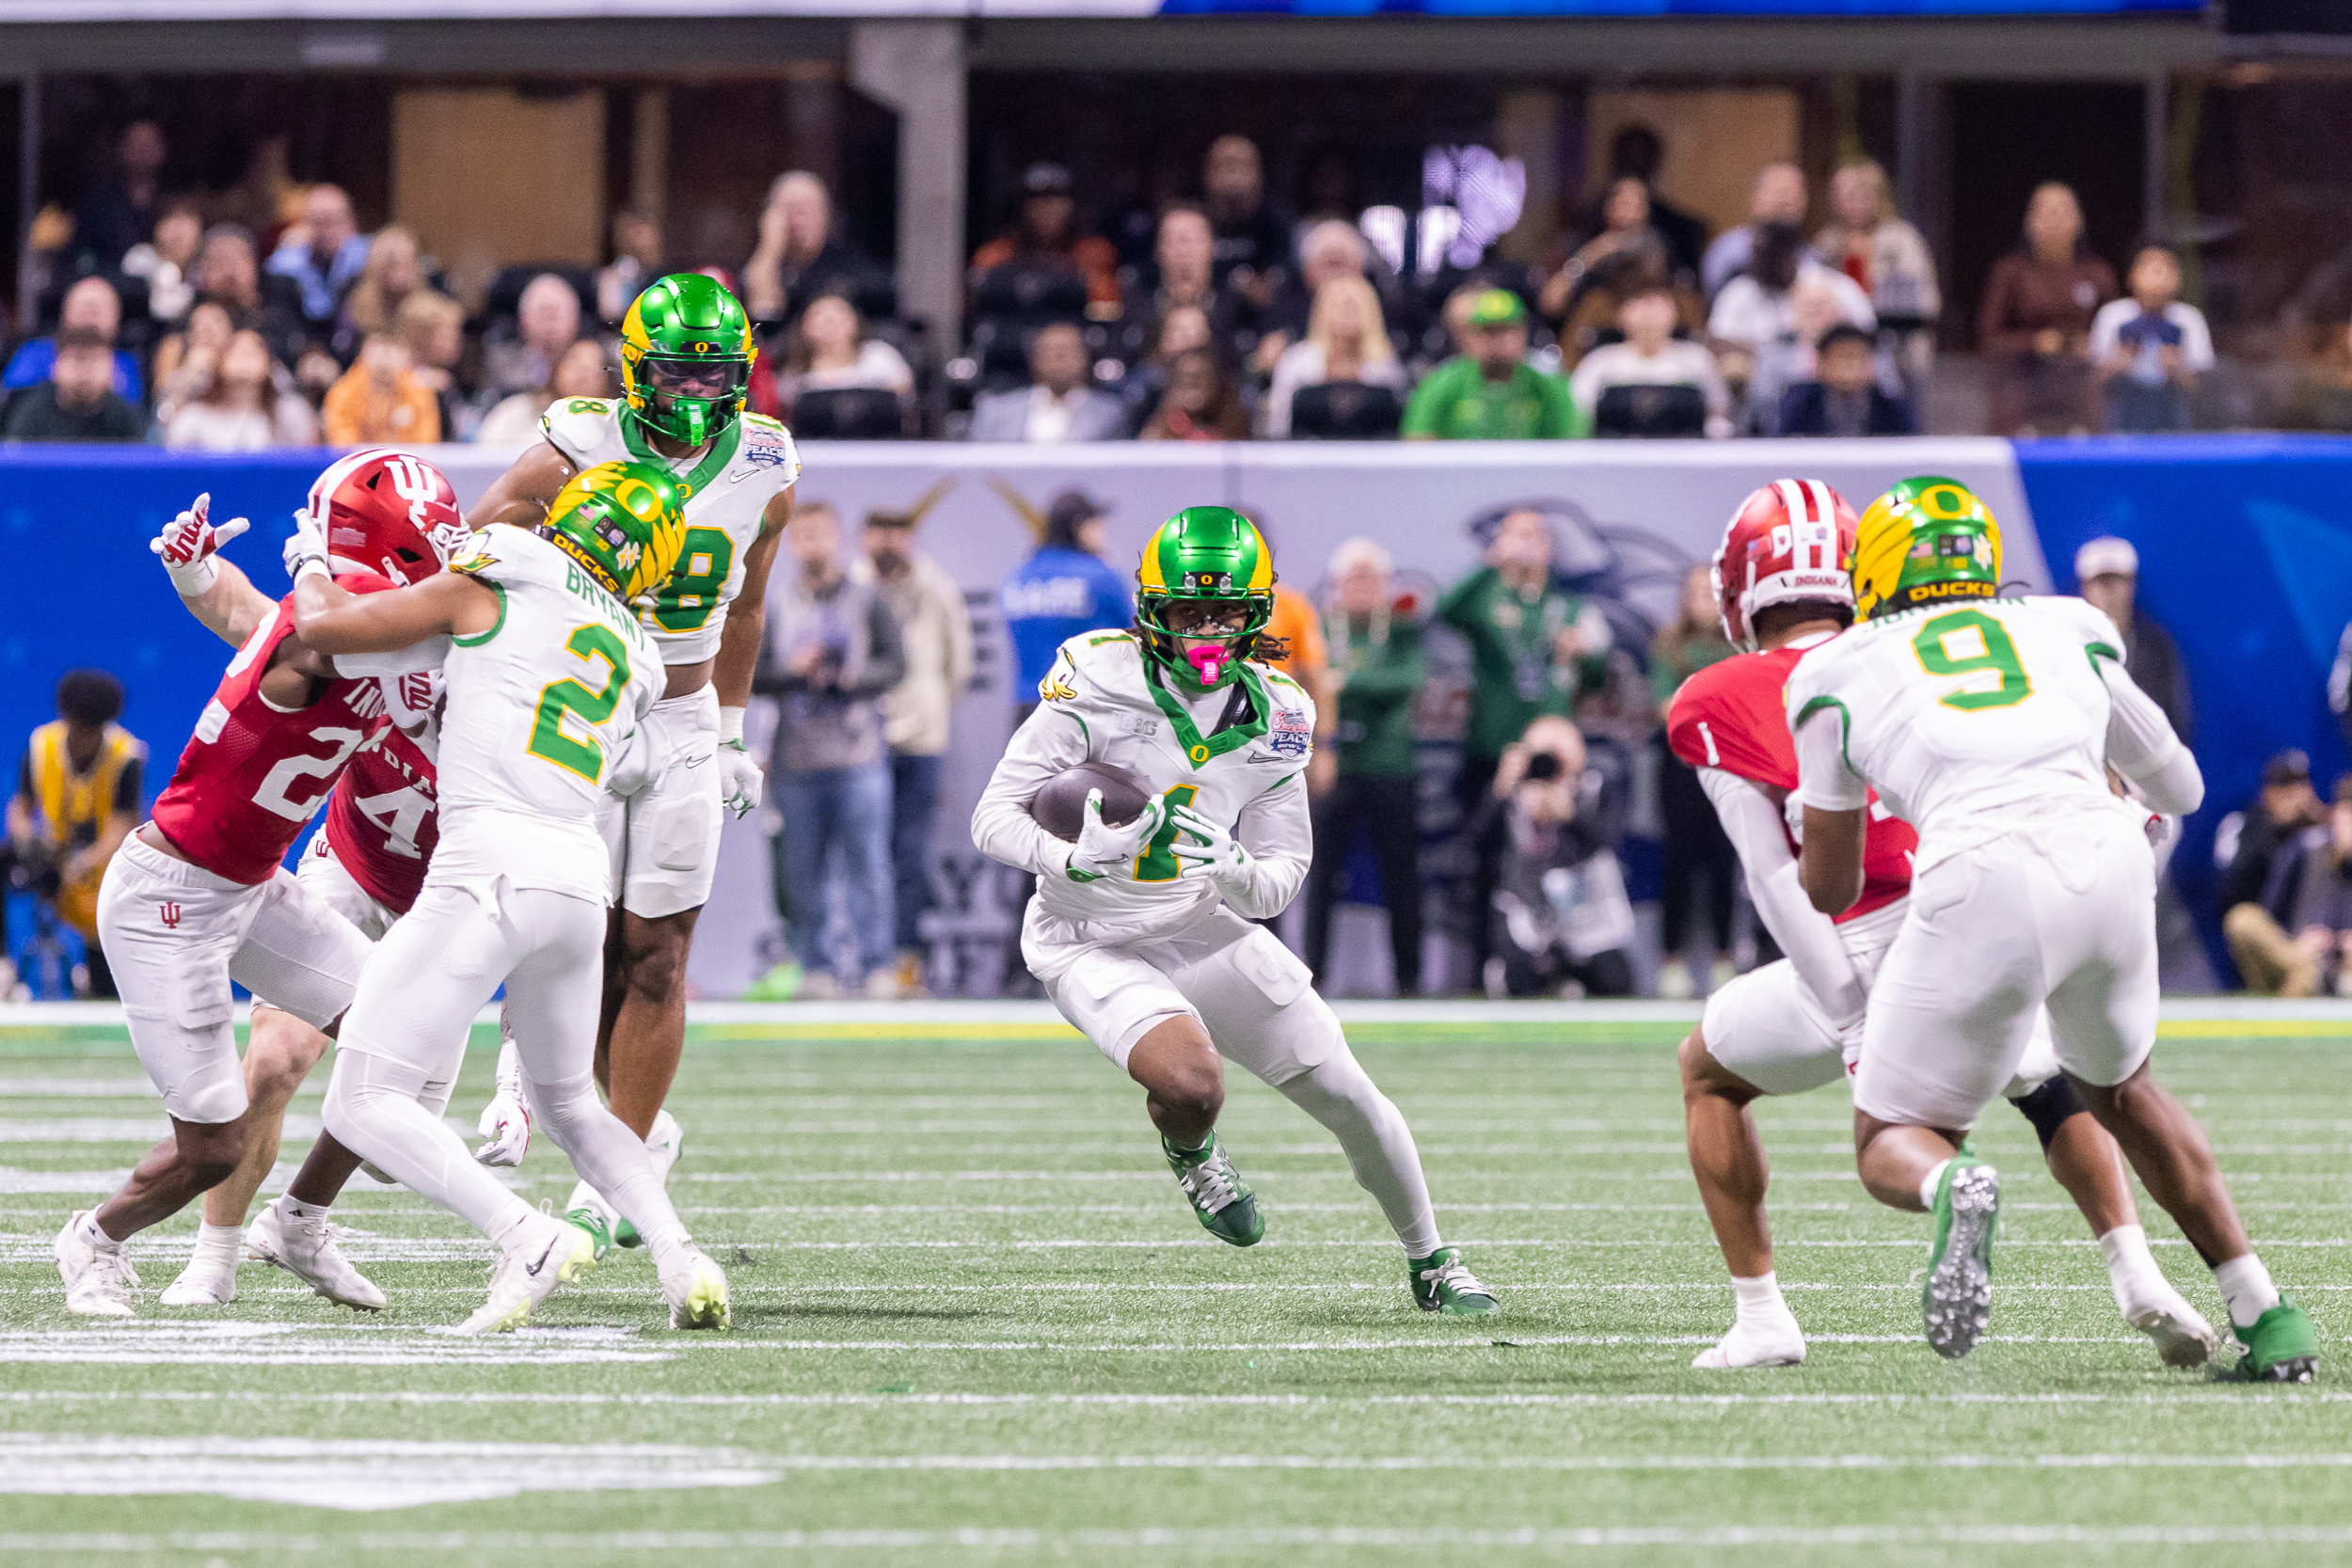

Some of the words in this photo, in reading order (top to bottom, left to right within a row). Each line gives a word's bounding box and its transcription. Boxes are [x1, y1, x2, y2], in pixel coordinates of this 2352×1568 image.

[743, 443, 785, 458] PEACH
[1919, 483, 1974, 520] O
[552, 532, 619, 594] DUCKS
[1795, 575, 1838, 587] INDIANA
[564, 560, 646, 653] BRYANT
[1908, 581, 1995, 602] DUCKS
[1909, 607, 2036, 714] 9
[525, 621, 633, 786] 2
[1189, 744, 1210, 764] O
[1271, 731, 1310, 746] PEACH
[354, 785, 437, 861] 4
[1133, 783, 1200, 883] 1
